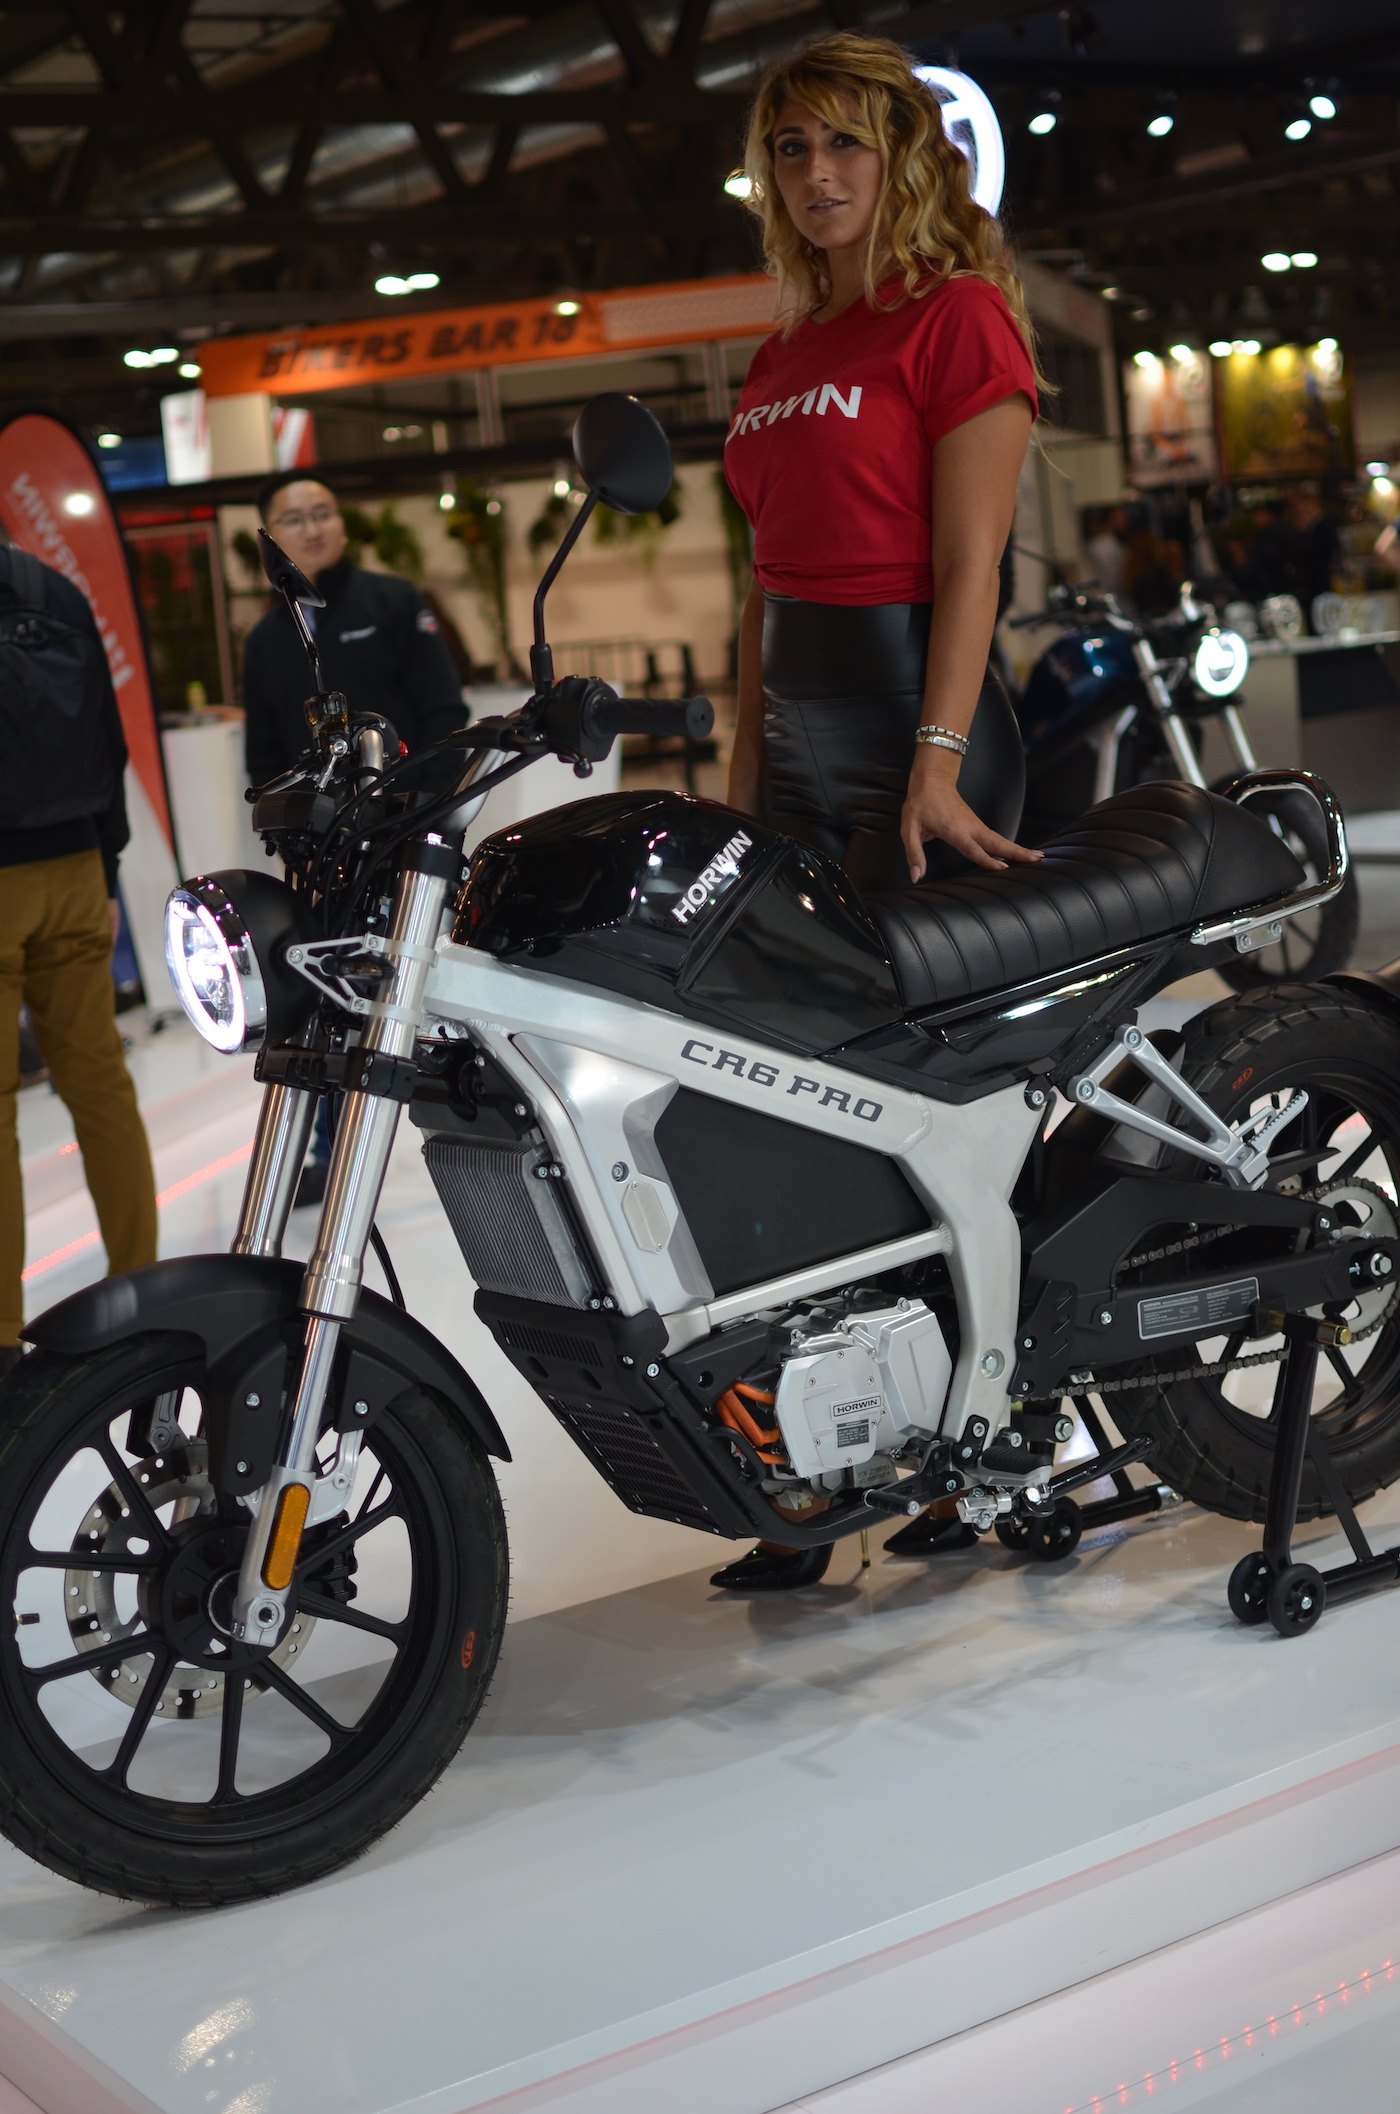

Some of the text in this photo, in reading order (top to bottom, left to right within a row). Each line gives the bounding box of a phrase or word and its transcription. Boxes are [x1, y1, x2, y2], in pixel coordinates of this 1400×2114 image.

[258, 330, 412, 379] BIKERS
[427, 318, 519, 359] BAR
[671, 829, 754, 924] HORWIN
[681, 1039, 884, 1123] CR6 PRO
[837, 1399, 878, 1413] HORWIN
